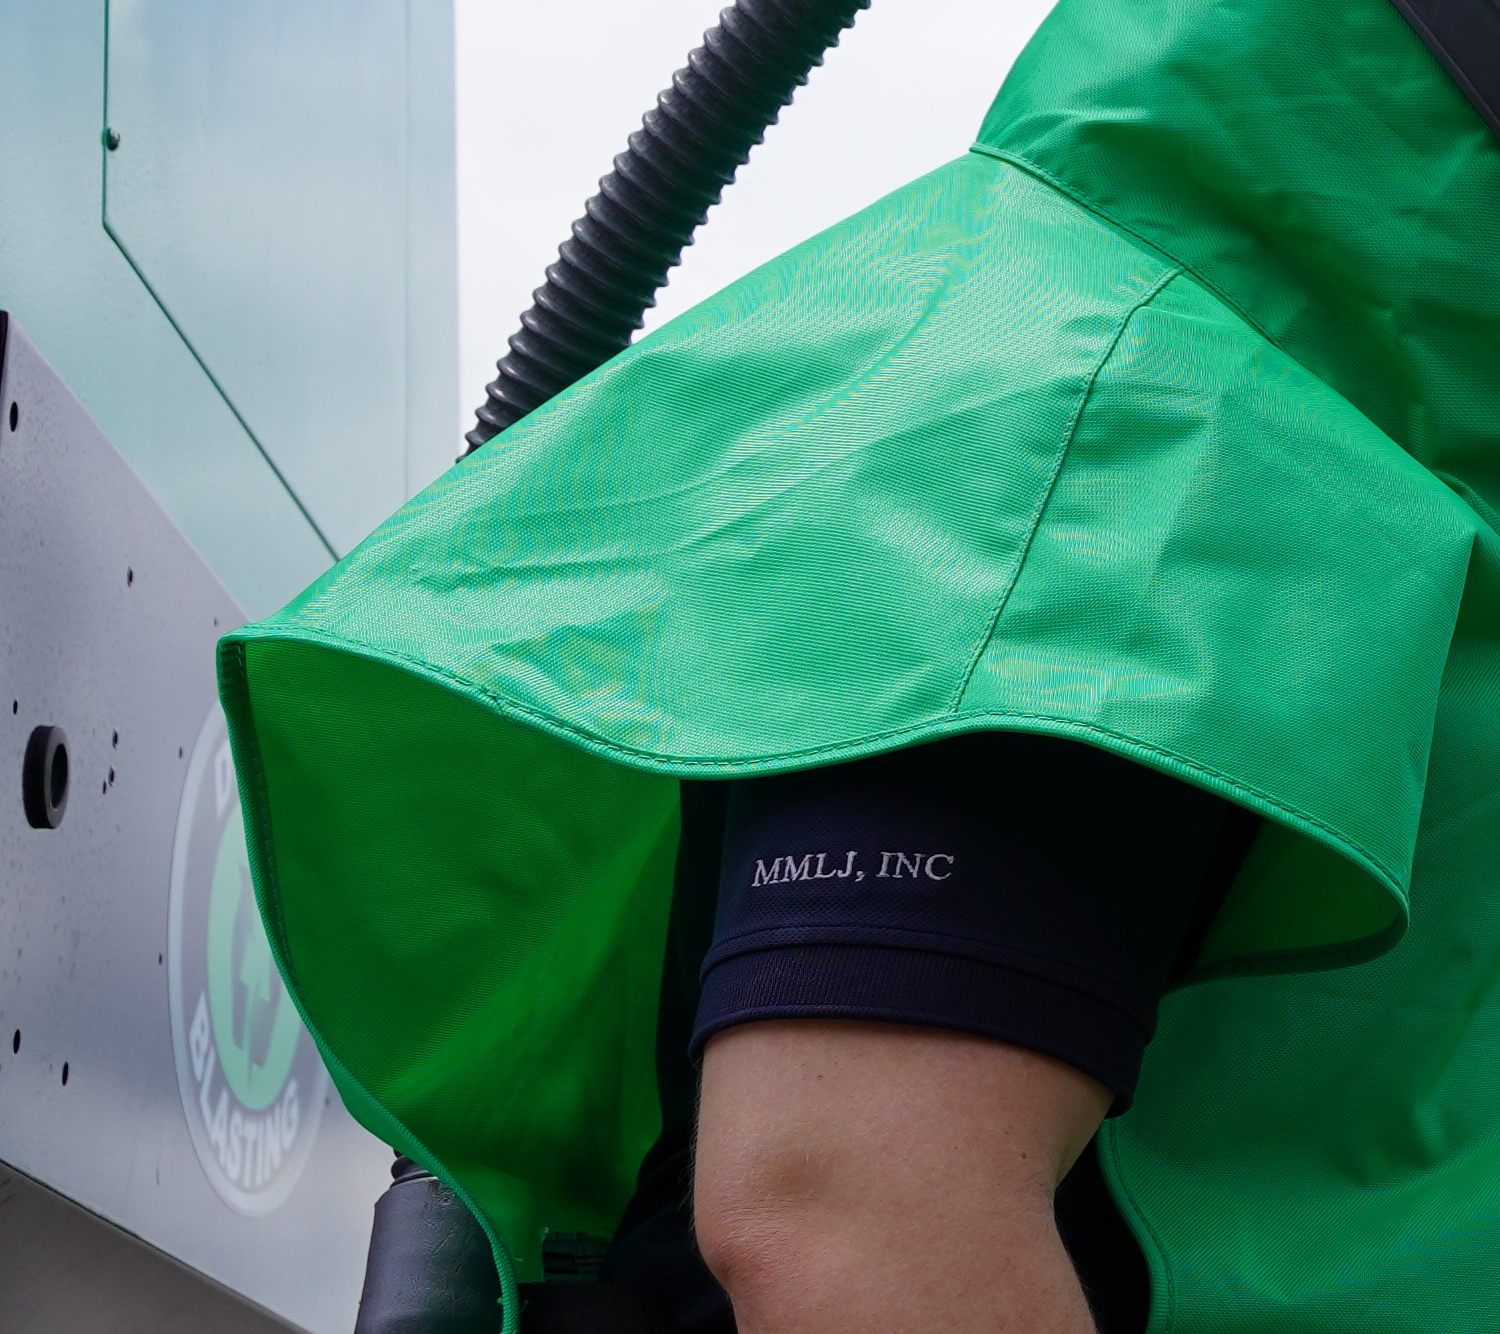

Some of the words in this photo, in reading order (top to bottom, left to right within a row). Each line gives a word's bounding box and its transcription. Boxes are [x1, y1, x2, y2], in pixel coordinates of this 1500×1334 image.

[751, 850, 866, 887] MMLJ,
[876, 851, 955, 881] INC
[189, 992, 298, 1188] BLASTING
